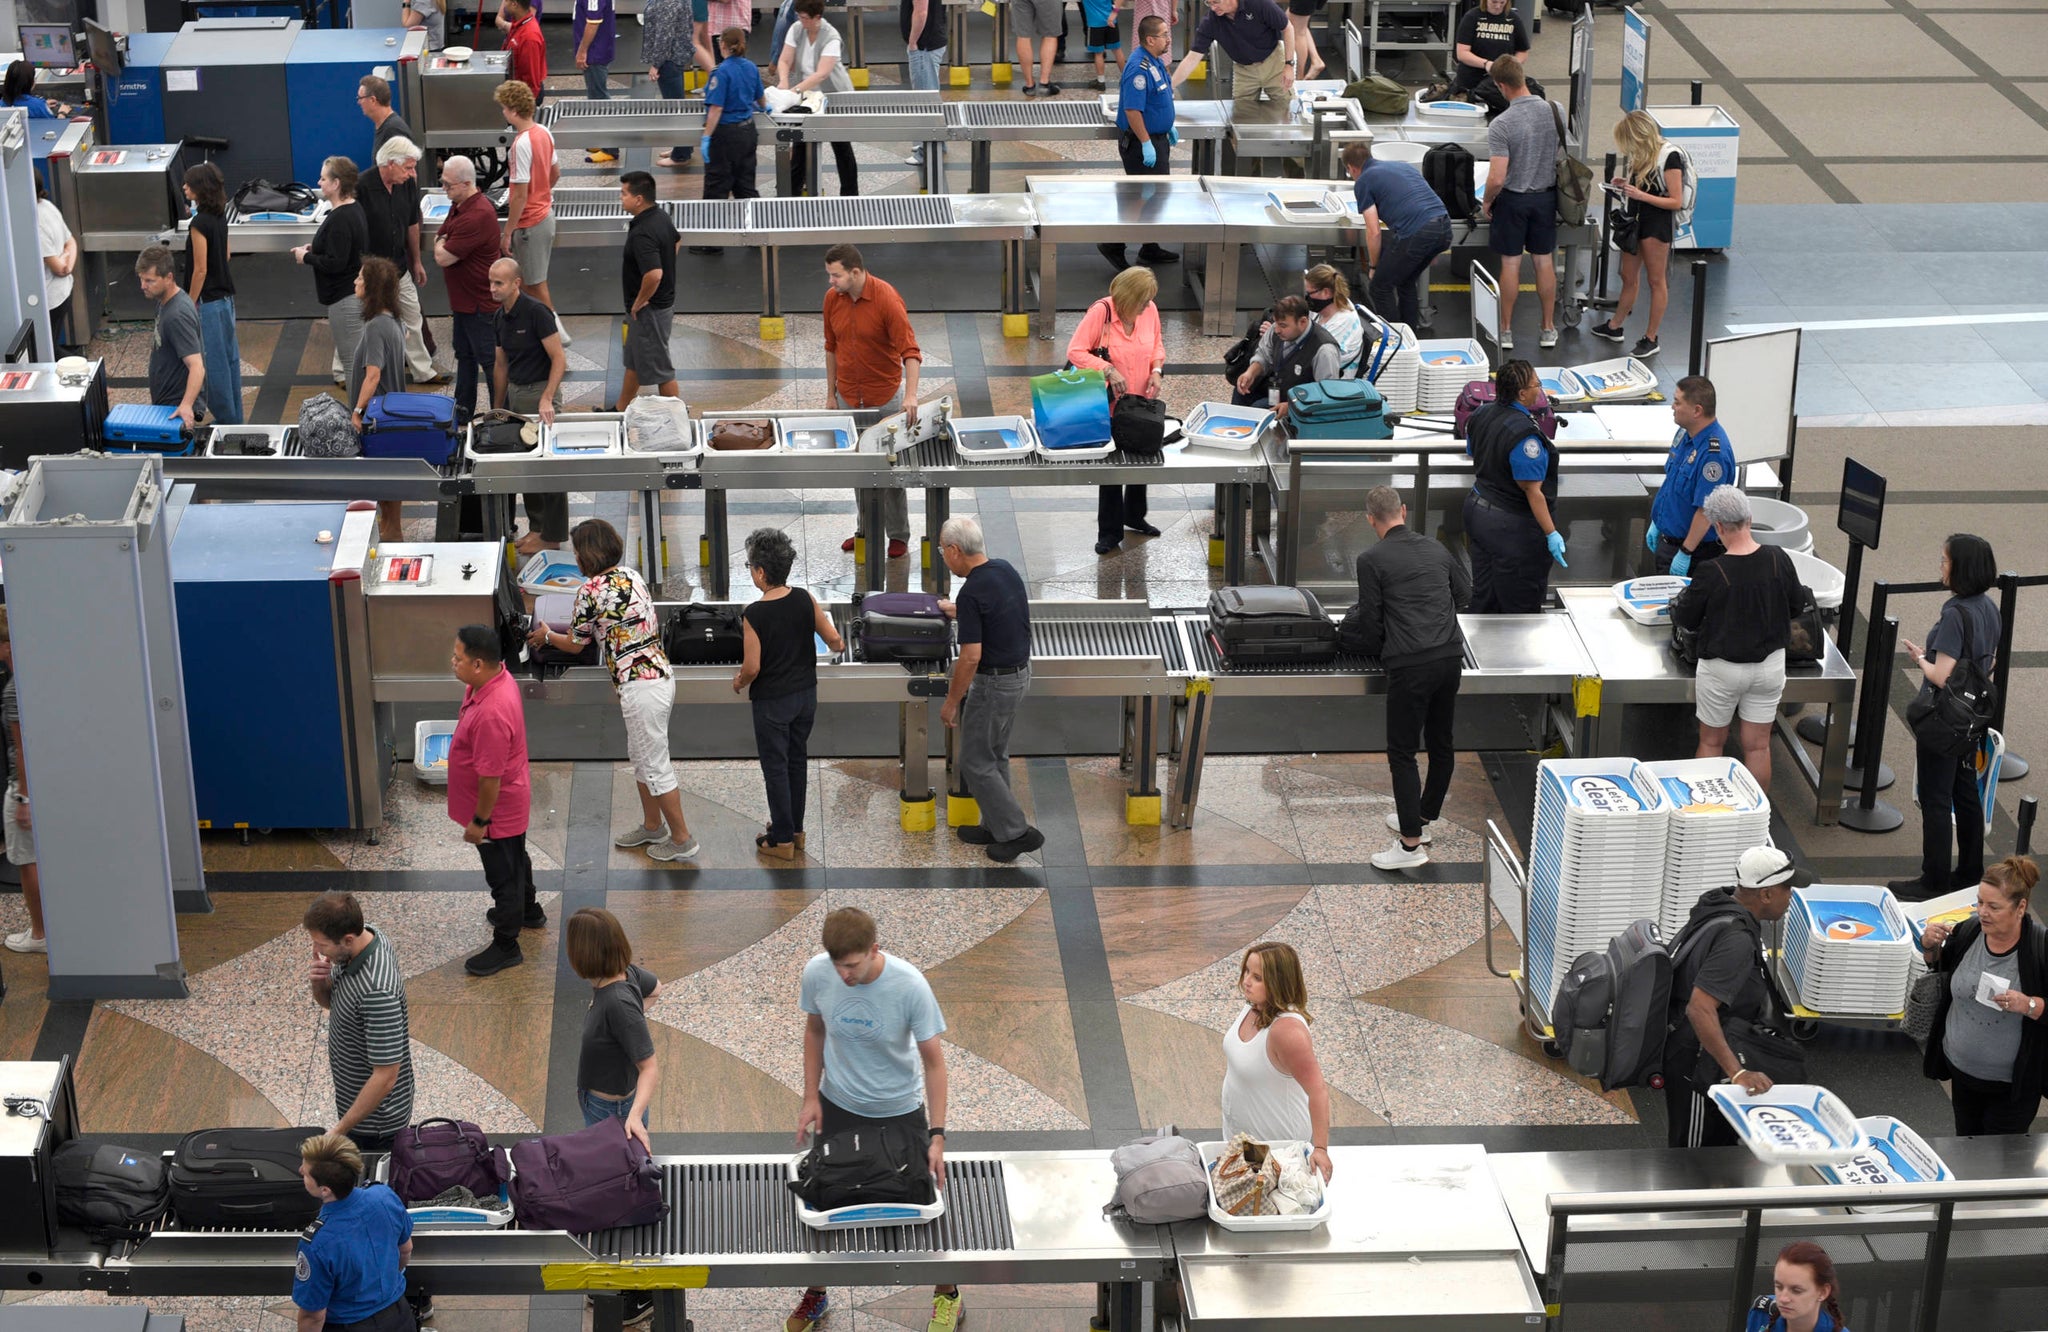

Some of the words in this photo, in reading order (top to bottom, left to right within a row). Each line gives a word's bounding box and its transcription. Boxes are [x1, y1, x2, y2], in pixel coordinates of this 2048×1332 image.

[1476, 22, 1515, 34] COLORADO
[1477, 32, 1511, 41] FOOTBALL
[1605, 787, 1623, 803] Let's
